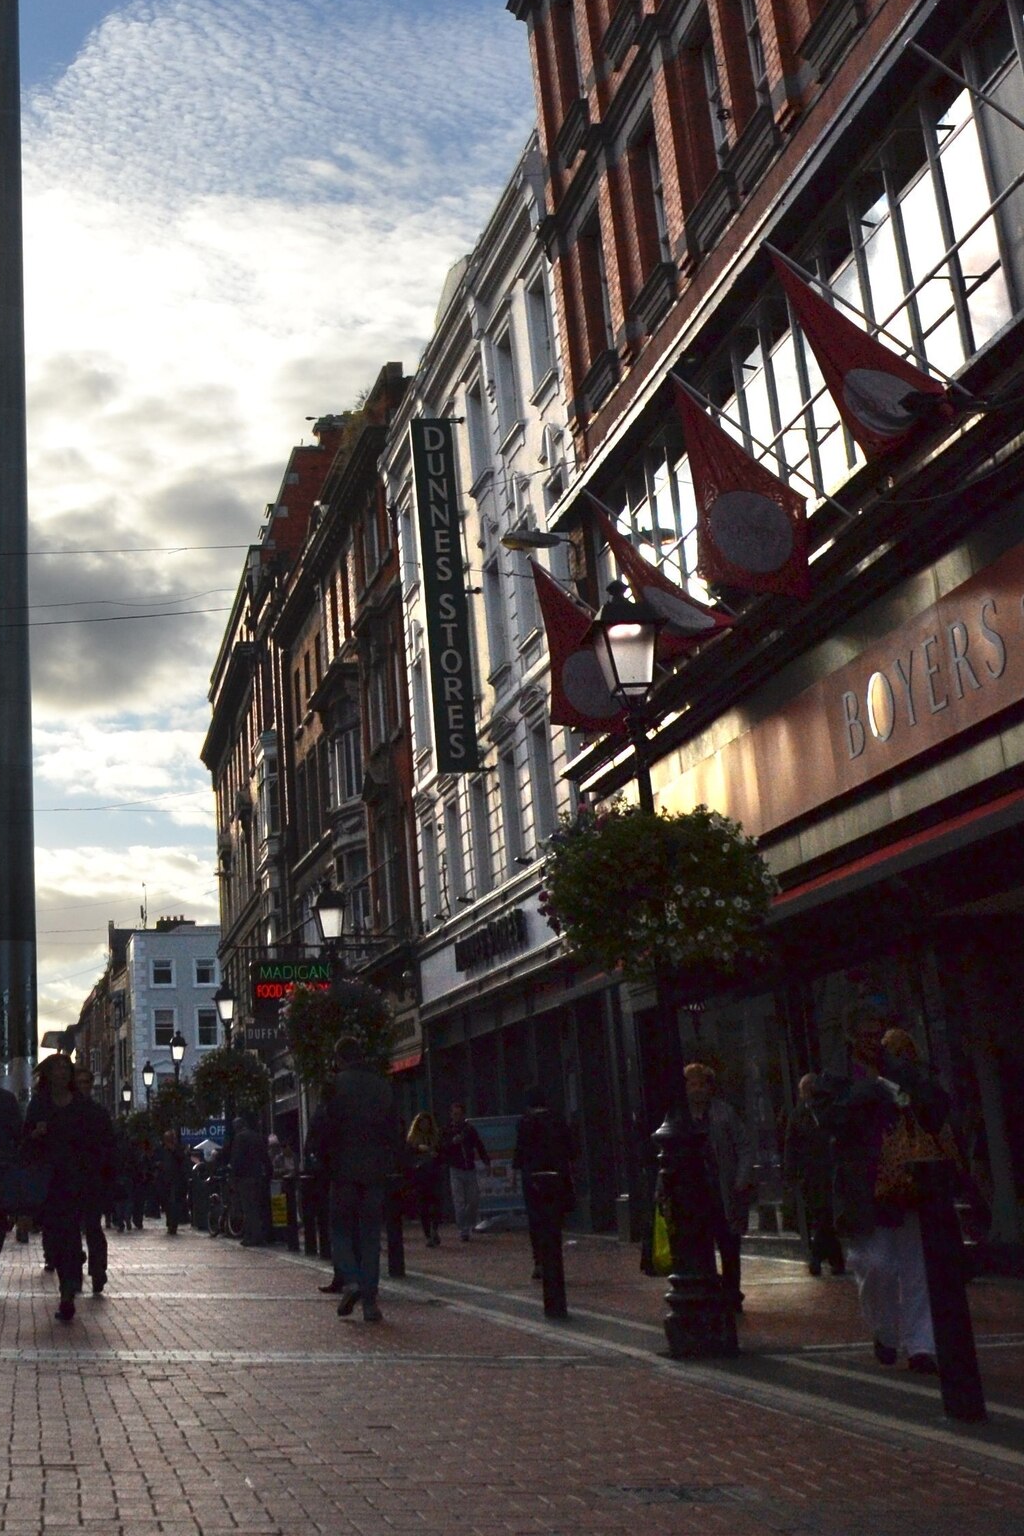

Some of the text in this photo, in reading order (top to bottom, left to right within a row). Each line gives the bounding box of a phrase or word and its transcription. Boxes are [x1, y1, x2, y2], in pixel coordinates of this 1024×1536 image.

[423, 426, 465, 759] DUNNES STORES
[843, 596, 1007, 760] BOYERS
[247, 1028, 278, 1040] DUFFY
[256, 983, 283, 998] FOOD
